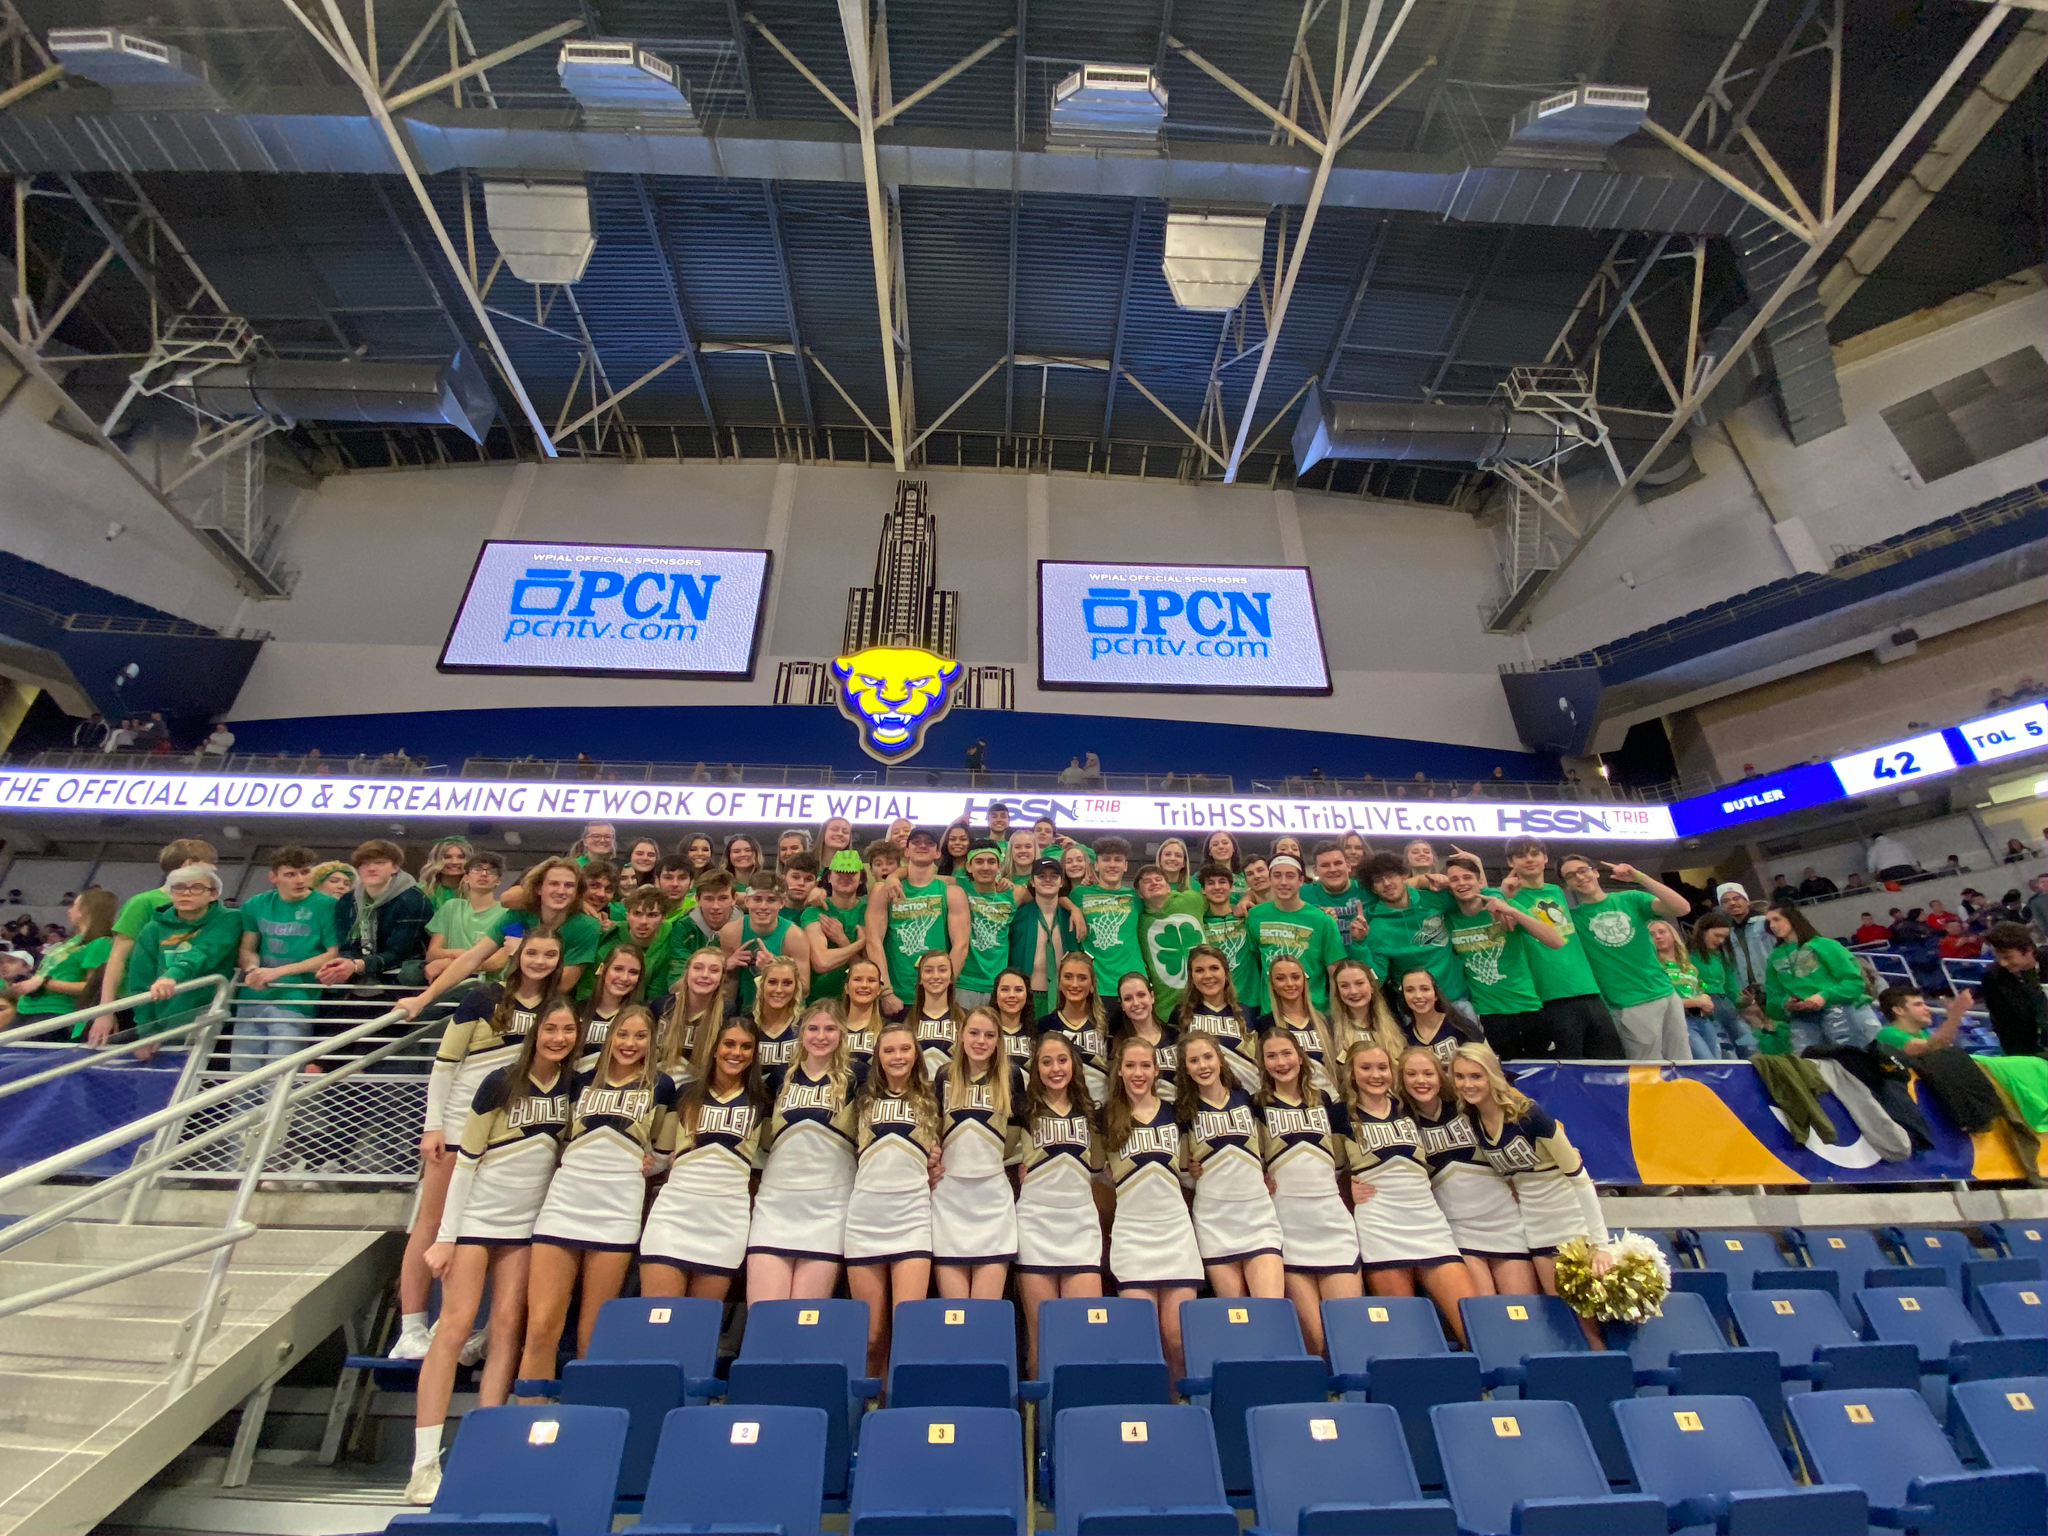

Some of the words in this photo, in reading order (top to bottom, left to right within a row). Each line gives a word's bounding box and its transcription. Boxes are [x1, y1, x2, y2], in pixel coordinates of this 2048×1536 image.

[532, 552, 573, 562] WPIAL
[575, 554, 631, 564] OFFICIAL
[634, 556, 702, 566] SPONSORS
[1088, 573, 1127, 582] WPIAL
[1129, 574, 1183, 583] OFFICIAL
[1185, 575, 1248, 584] SPONSORS
[566, 570, 722, 621] PCN
[1138, 589, 1272, 638] PCN
[503, 618, 699, 643] pcntv.com
[1090, 637, 1269, 660] pcntv.com
[1972, 728, 2016, 749] TOL
[2024, 720, 2044, 737] 5
[1873, 751, 1922, 779] 42
[0, 777, 50, 803] THE
[55, 778, 189, 806] OFFICIAL
[200, 780, 303, 808] AUDIO
[310, 783, 334, 809] &
[343, 783, 528, 812] STREAMING
[536, 788, 692, 817] NETWORK
[705, 791, 746, 818] OF
[757, 792, 813, 819] THE
[826, 794, 919, 821] WPIAL
[1084, 799, 1121, 813] TRIB
[1722, 789, 1786, 814] BUTLER
[1154, 801, 1476, 833] TribHSSN.TribLIVE.com
[1496, 808, 1611, 834] HSSN
[1612, 810, 1650, 826] TRIB
[1260, 929, 1295, 939] SECTION
[916, 1019, 958, 1044] UTLE
[508, 1093, 570, 1128] BUTLE
[686, 1104, 758, 1140] UTLER
[870, 1098, 920, 1126] UTLE
[1264, 1105, 1333, 1140] BUTLER
[1192, 1105, 1256, 1145] BUTLER
[1420, 1113, 1480, 1158] UTLER
[741, 1427, 749, 1438] 2
[938, 1428, 945, 1439] 3
[1131, 1426, 1137, 1437] 4
[1502, 1421, 1510, 1432] 6
[1684, 1415, 1692, 1427] 7
